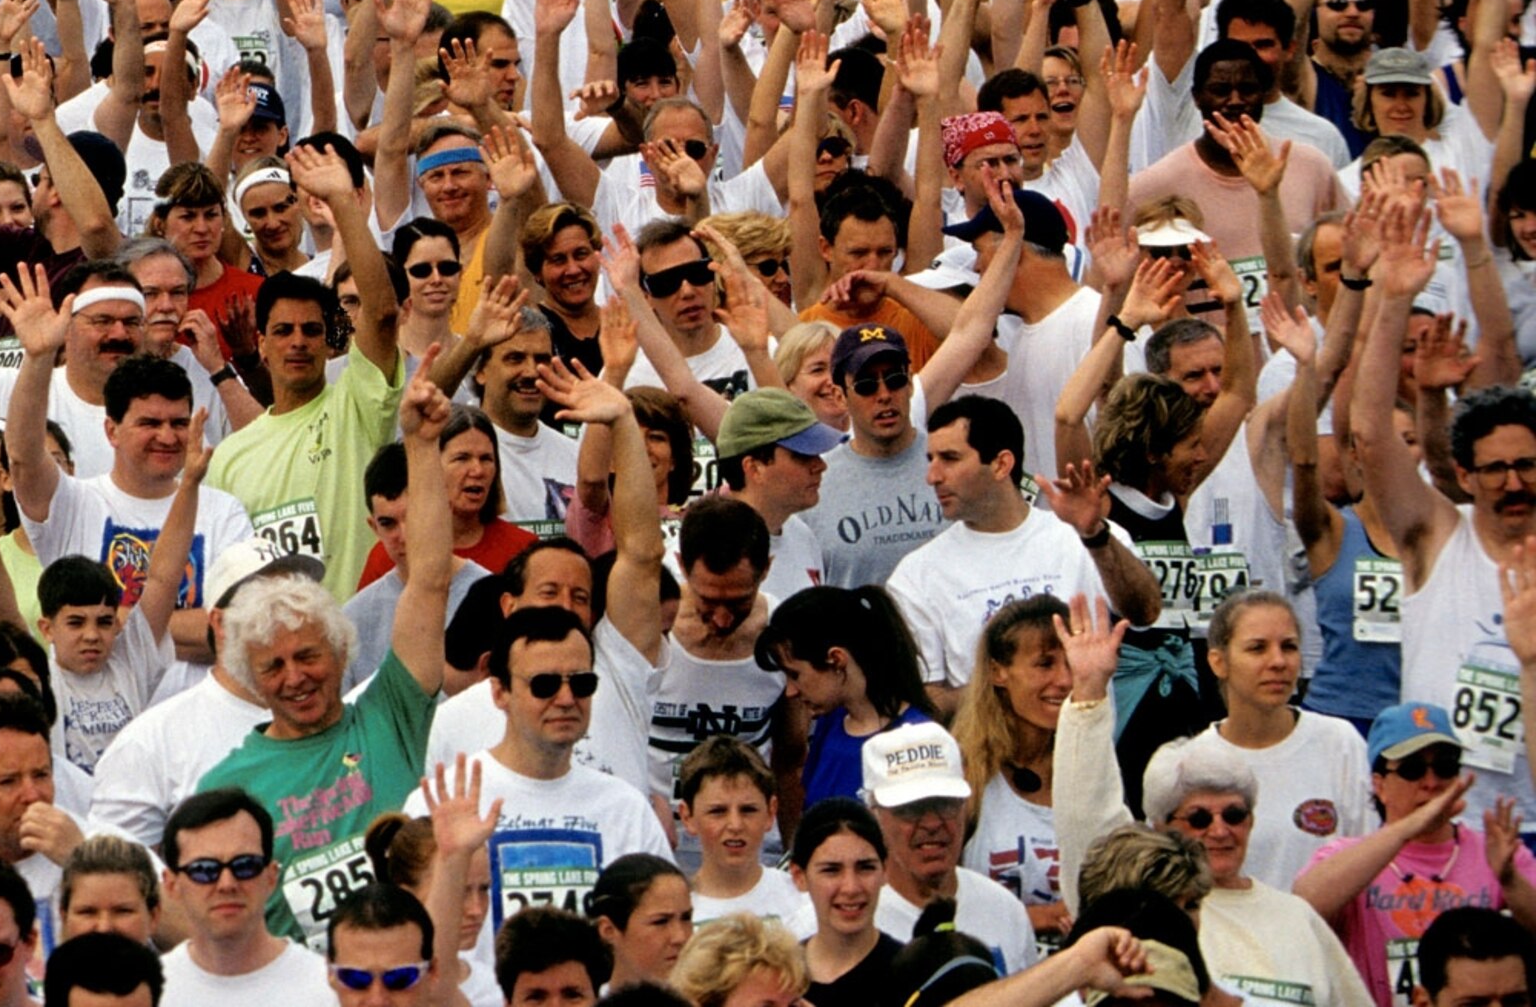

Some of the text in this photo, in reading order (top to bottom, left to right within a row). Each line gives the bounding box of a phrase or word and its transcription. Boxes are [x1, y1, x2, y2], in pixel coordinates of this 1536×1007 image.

[859, 327, 886, 343] M
[836, 504, 894, 545] OLD
[1145, 560, 1197, 600] 276
[1358, 574, 1399, 613] 52
[885, 744, 945, 767] PEDDIE
